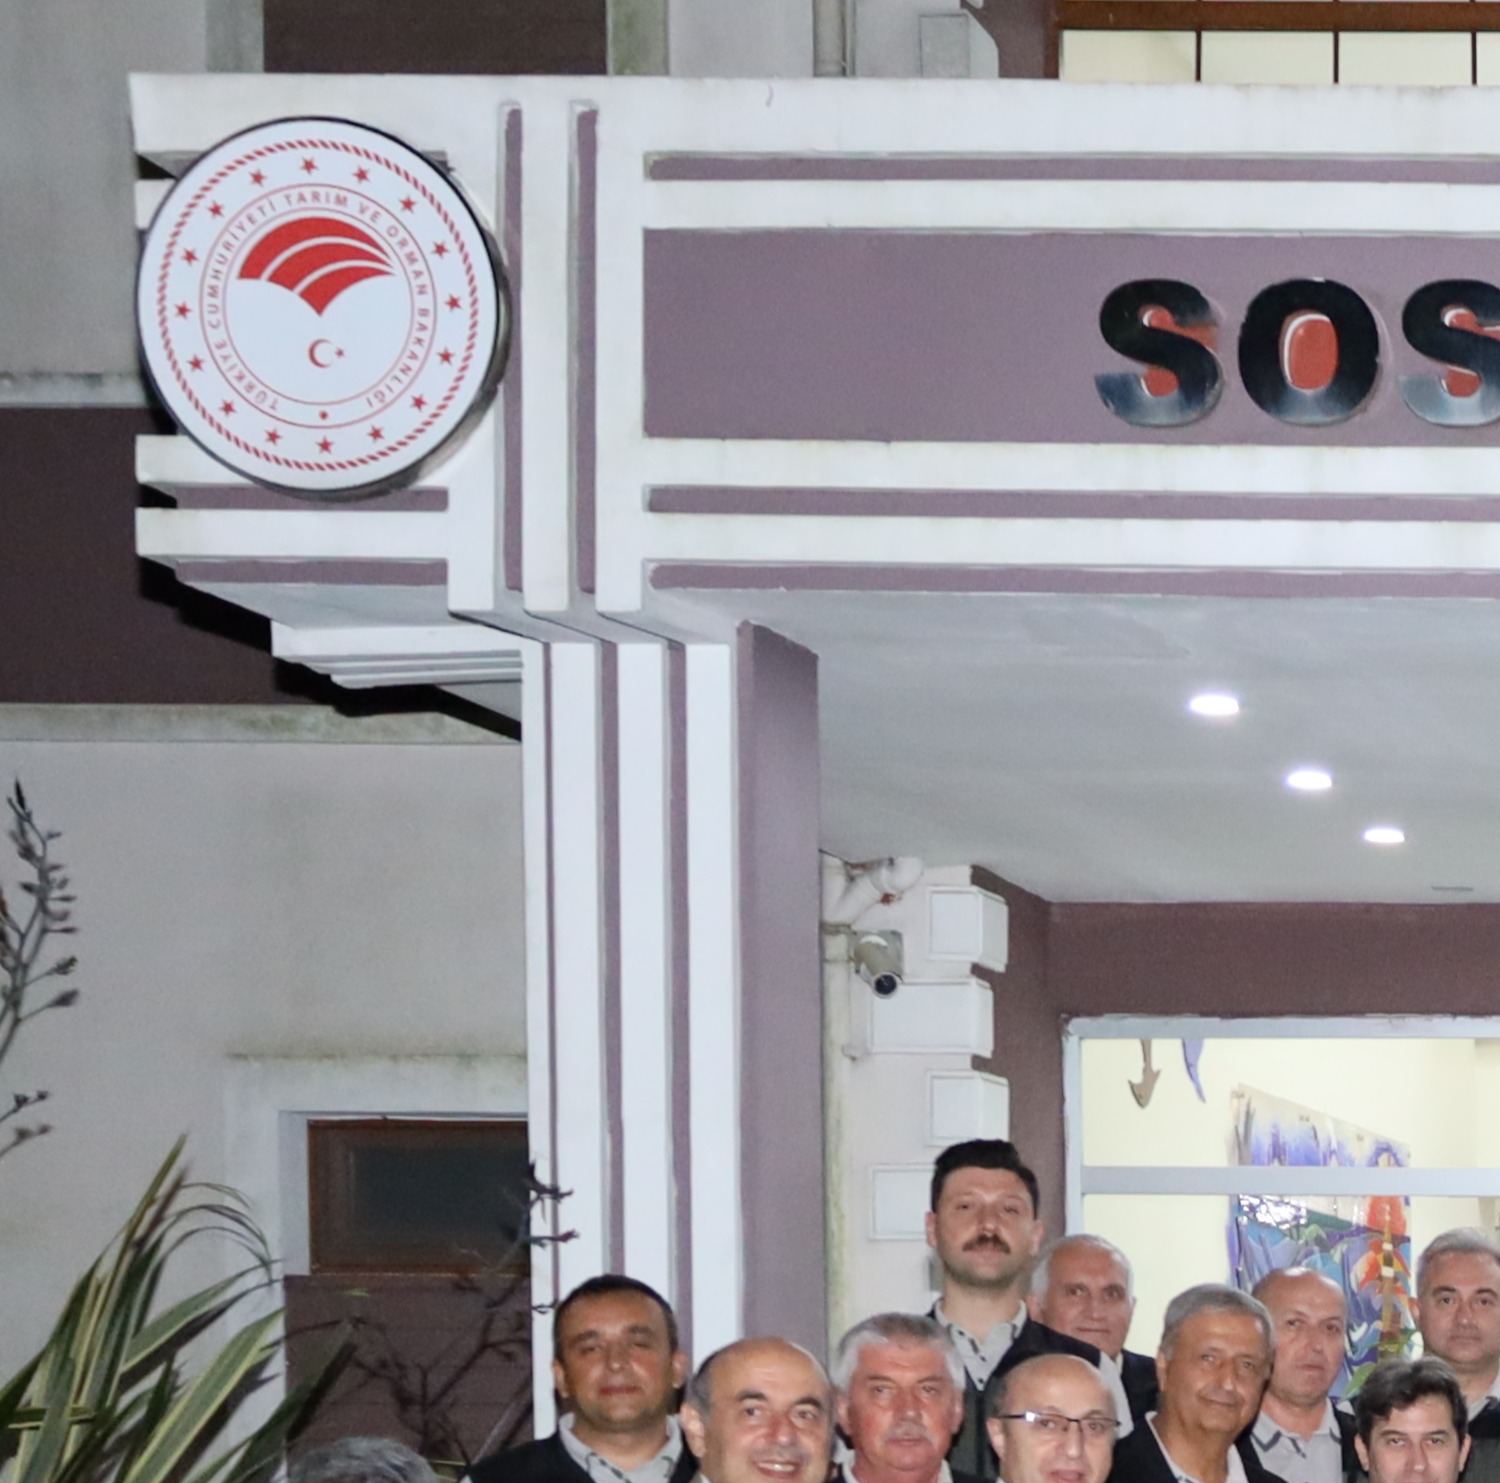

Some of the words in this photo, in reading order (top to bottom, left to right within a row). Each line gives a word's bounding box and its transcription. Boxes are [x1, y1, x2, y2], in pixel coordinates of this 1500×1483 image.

[283, 190, 348, 208] TARIM
[358, 201, 381, 223] VE
[206, 196, 277, 329] CUMHURİYETİ
[386, 225, 429, 296] ORMAN
[213, 339, 279, 411] TÜRKİYE
[365, 307, 431, 408] BAKANLIĞI
